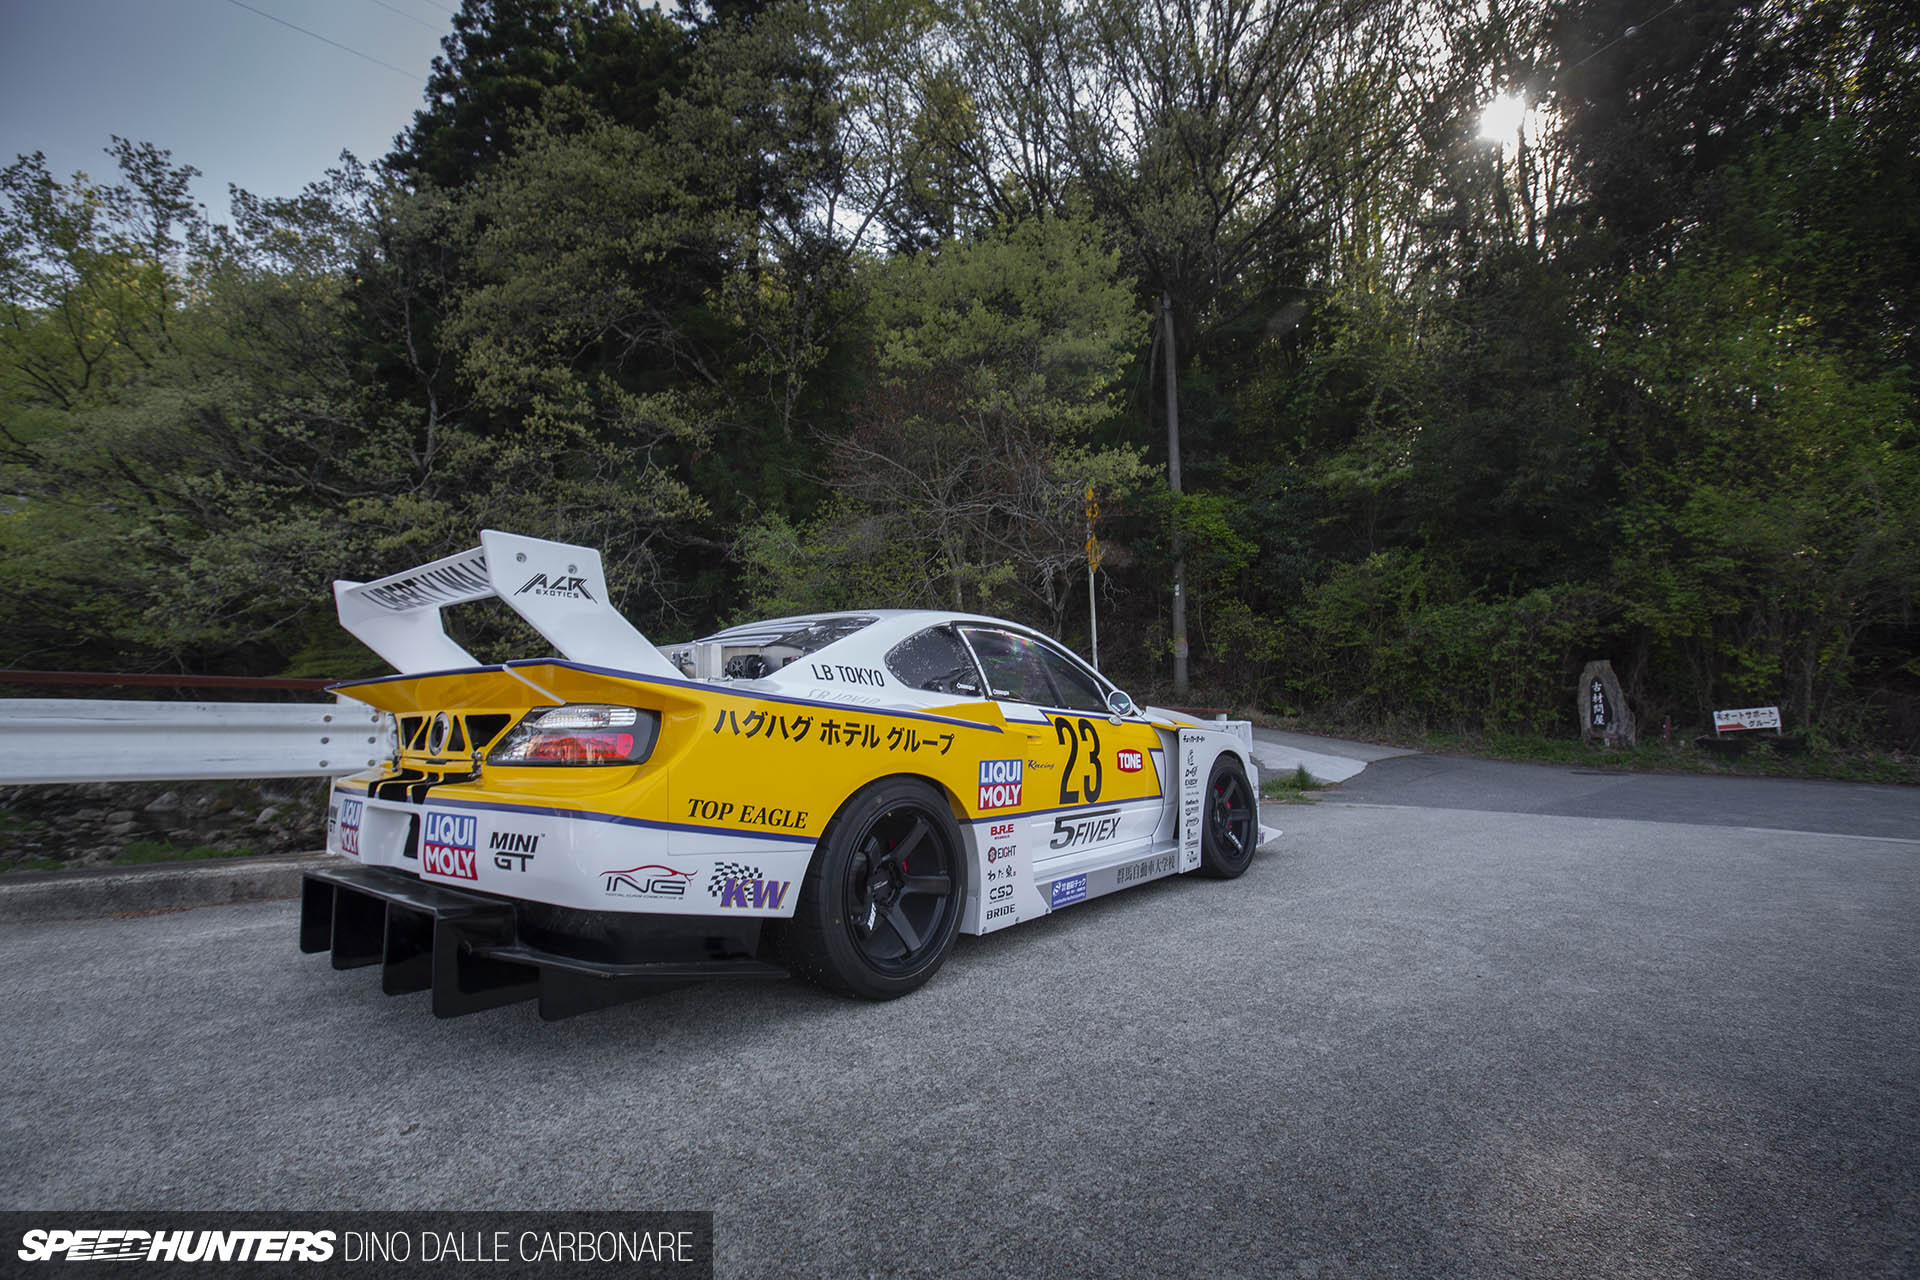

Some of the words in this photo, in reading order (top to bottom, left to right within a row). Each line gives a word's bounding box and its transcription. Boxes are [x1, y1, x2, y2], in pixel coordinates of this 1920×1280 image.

[361, 574, 459, 611] LIBERTY
[534, 588, 578, 599] EXOTICS
[811, 664, 834, 681] LB
[836, 665, 885, 687] TOKYO
[713, 709, 814, 743] ハグハグ
[820, 719, 880, 749] ホテル
[887, 726, 955, 756] グループ
[980, 760, 1022, 784] LIQUI
[1027, 759, 1055, 770] Racing
[1054, 717, 1102, 805] 23
[1118, 752, 1142, 770] TONE
[979, 784, 1022, 809] MOLY
[343, 799, 362, 826] LIQUI
[688, 798, 734, 821] TOP
[738, 804, 809, 829] EAGLE
[427, 814, 475, 847] LIQUI
[990, 824, 1015, 837] B.R.E
[489, 832, 539, 853] MINI
[998, 845, 1017, 860] EIGHT
[426, 847, 475, 878] MOLY
[494, 851, 535, 873] GT
[606, 876, 687, 896] ING
[720, 877, 791, 910] KW
[989, 884, 1014, 901] CSD
[986, 904, 1016, 921] BRIDE
